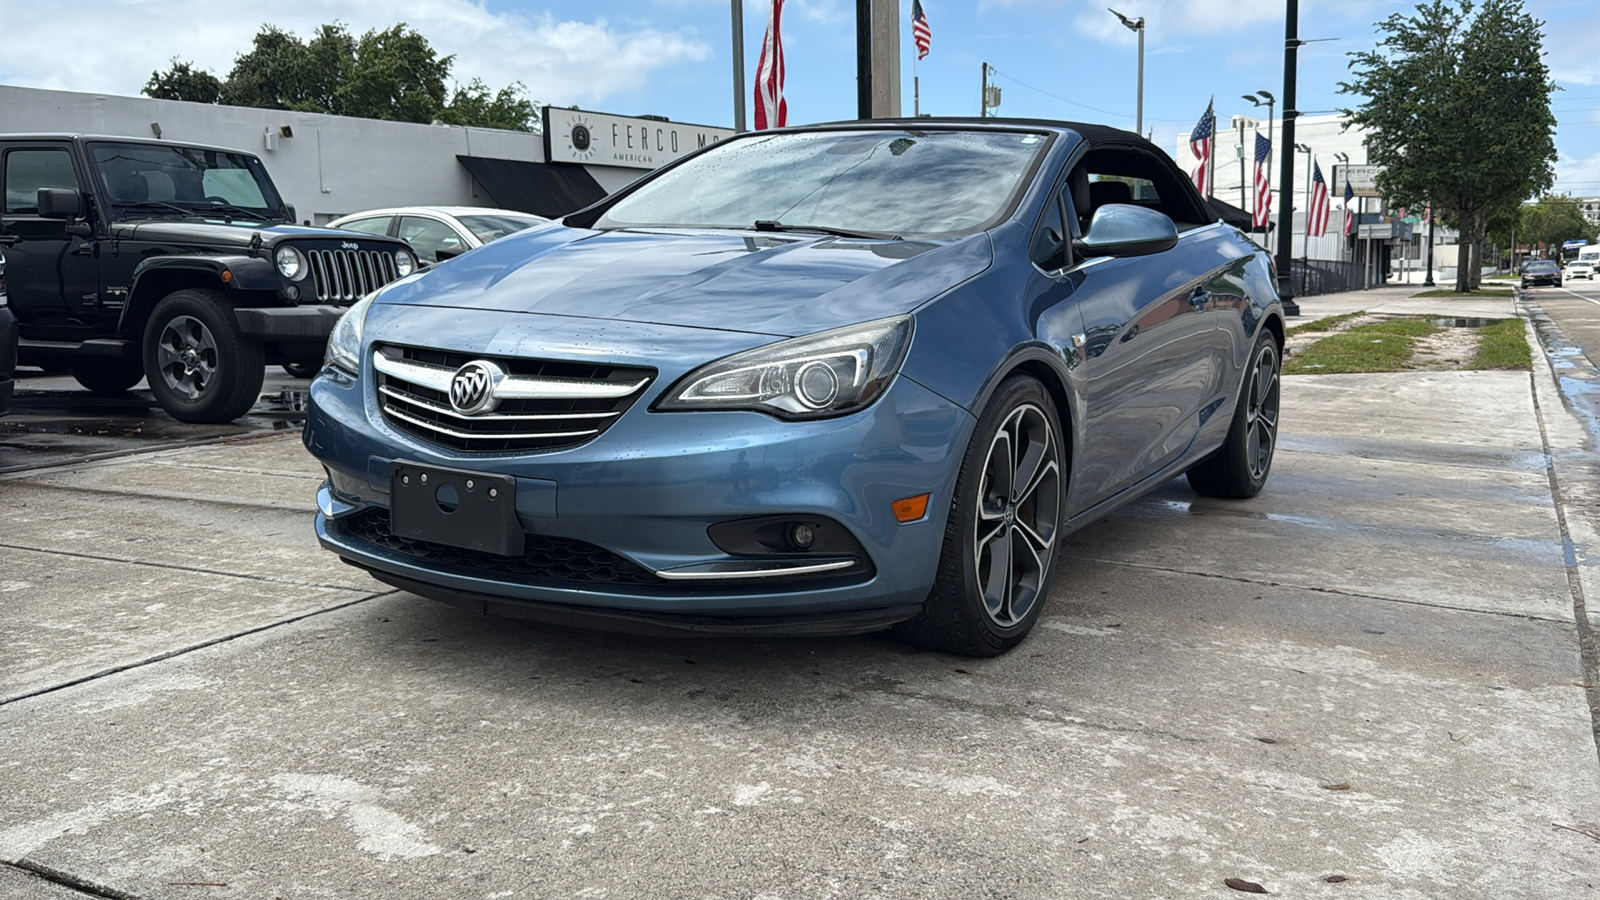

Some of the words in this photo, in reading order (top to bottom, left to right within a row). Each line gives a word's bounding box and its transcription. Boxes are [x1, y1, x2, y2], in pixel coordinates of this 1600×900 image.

[612, 123, 678, 153] FERCO
[613, 153, 653, 163] AMERICAN
[341, 240, 359, 251] Jeep
